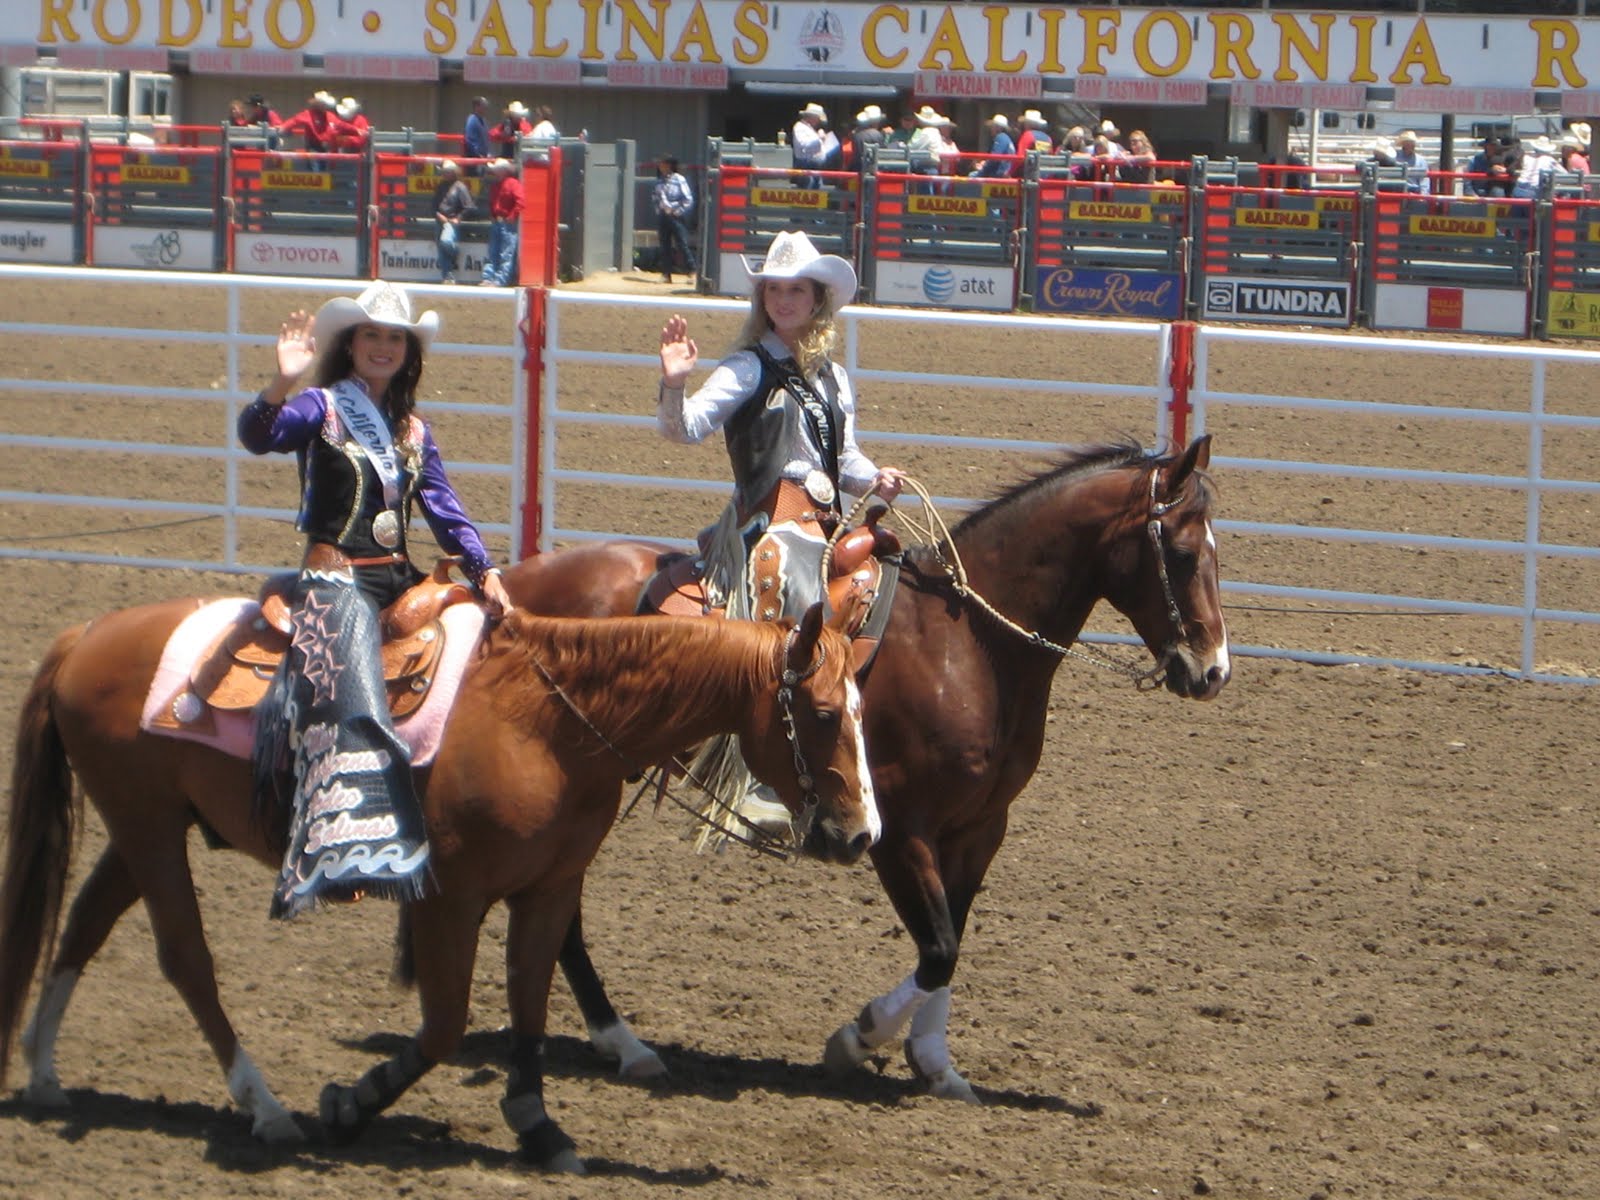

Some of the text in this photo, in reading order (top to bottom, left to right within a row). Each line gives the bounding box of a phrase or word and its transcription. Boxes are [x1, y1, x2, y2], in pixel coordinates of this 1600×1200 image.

[37, 0, 316, 49] RODEO
[423, 0, 770, 64] SALINAS
[860, 3, 1452, 86] CALIFORNIA
[935, 75, 992, 95] PAPAZIAN
[997, 77, 1040, 97] FAMILY
[1254, 85, 1304, 105] BAKER
[1311, 87, 1366, 107] FAMILY
[759, 190, 820, 207] SALINAS
[916, 197, 978, 214] SALINAS
[1078, 204, 1142, 219] SALINAS
[1244, 211, 1310, 227] SALINAS
[1418, 217, 1487, 235] SALINAS
[277, 246, 340, 264] TOYOTA
[960, 277, 996, 296] at&t
[1042, 266, 1172, 314] Crown Royal
[1240, 286, 1342, 315] TUNDRA
[303, 811, 399, 851] Salinas
